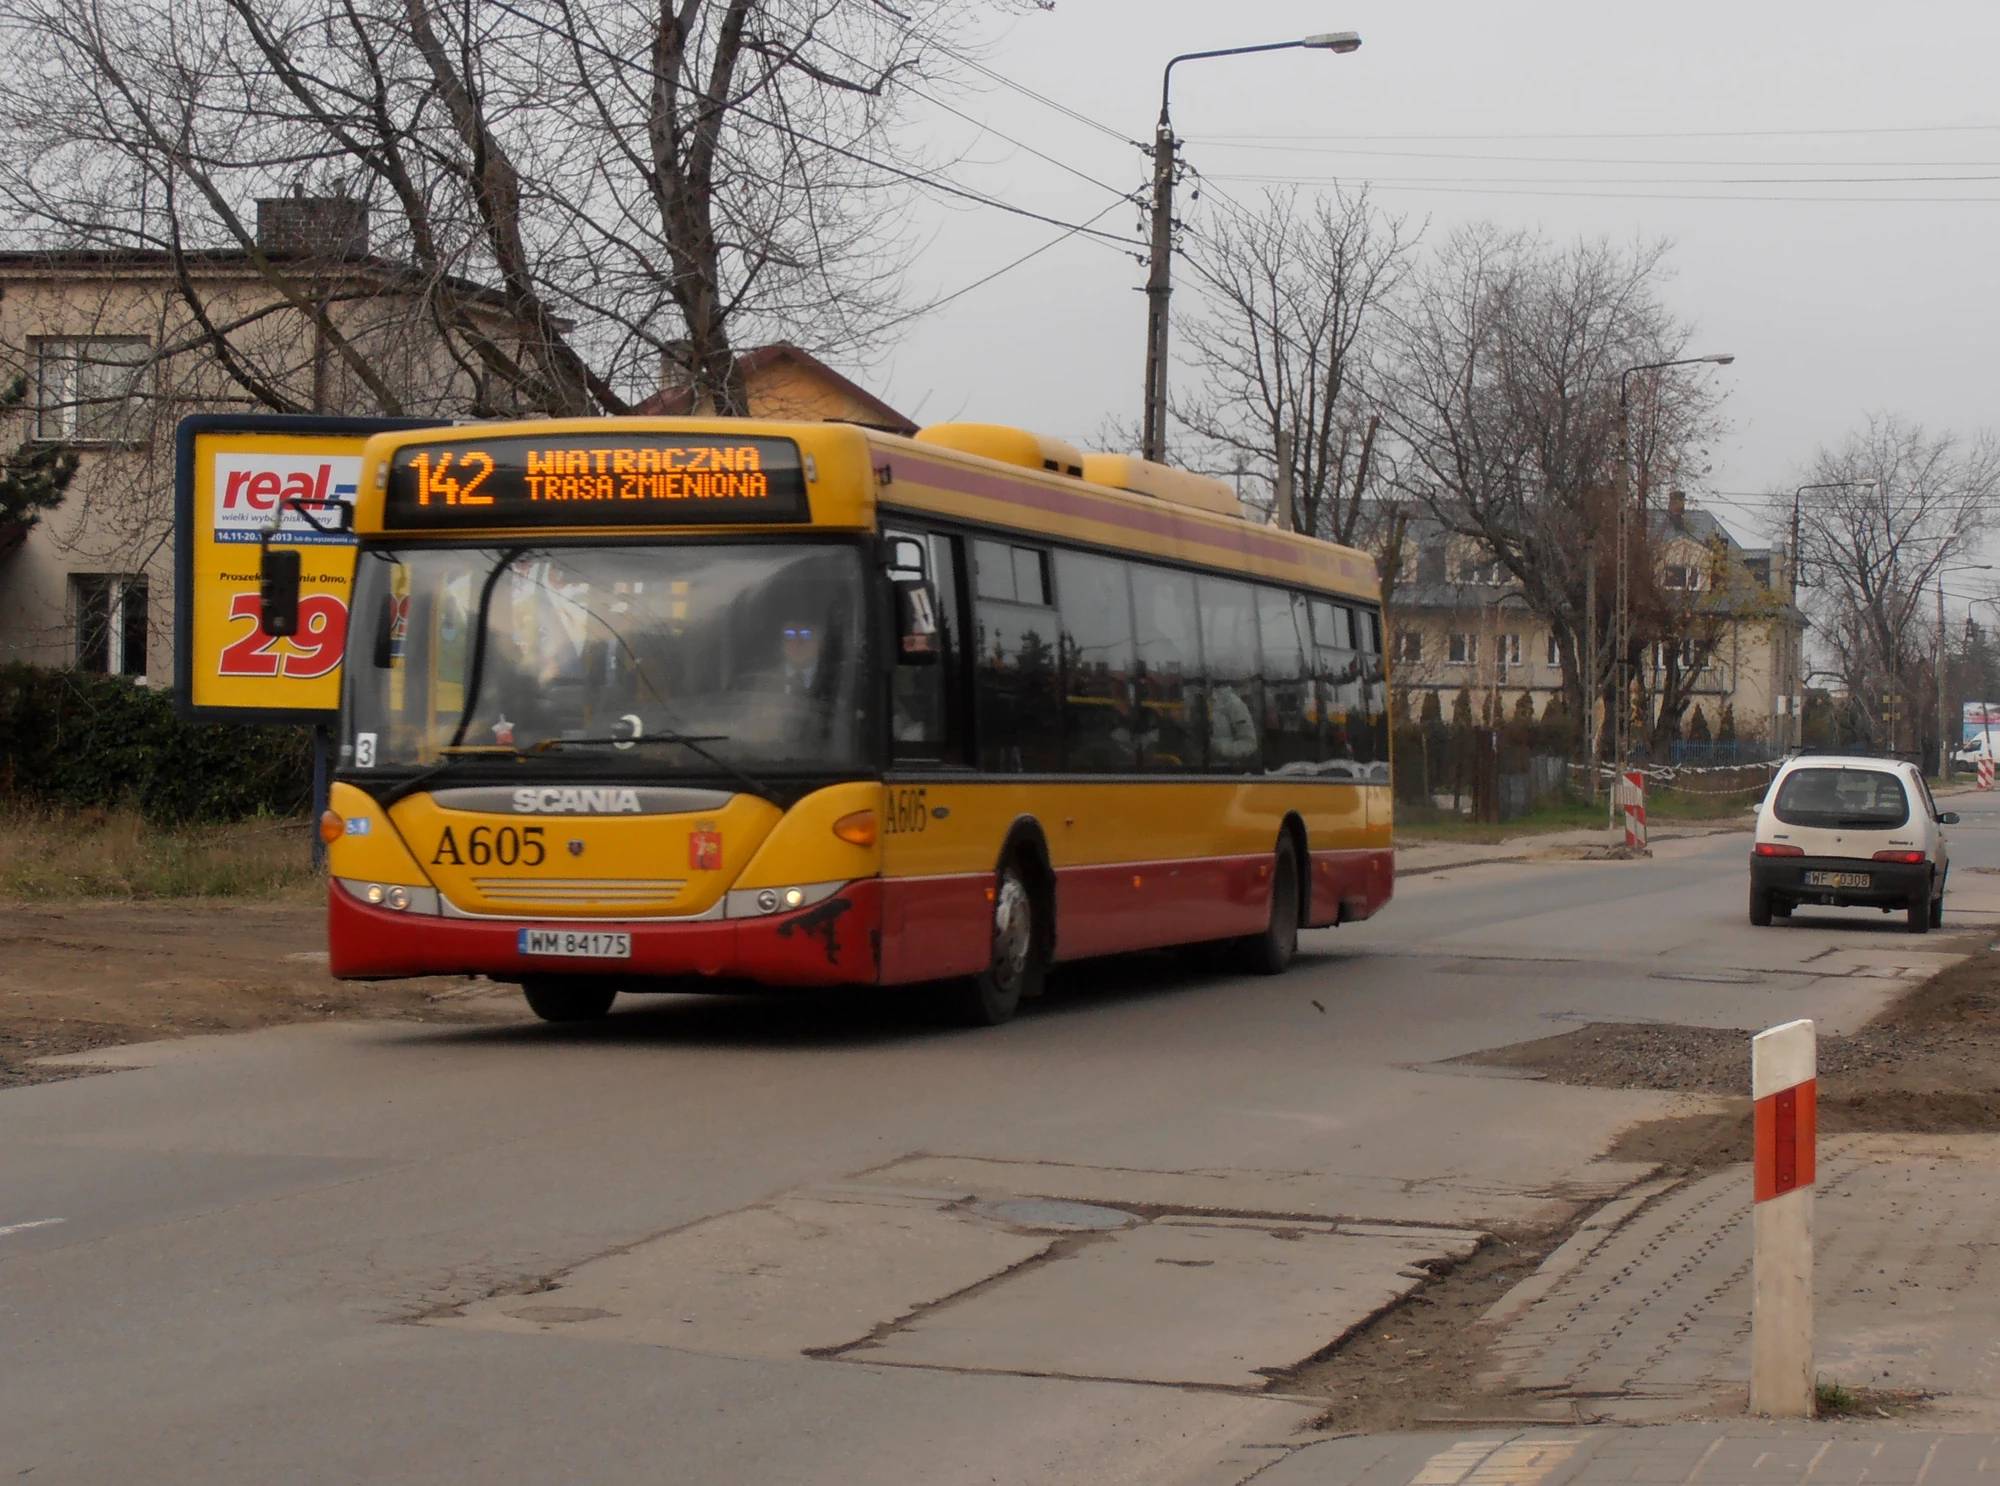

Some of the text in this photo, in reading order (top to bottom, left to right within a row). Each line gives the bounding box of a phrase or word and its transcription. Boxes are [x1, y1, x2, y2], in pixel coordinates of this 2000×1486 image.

[526, 446, 761, 475] WIATRACZNA
[408, 451, 495, 505] 142
[524, 472, 768, 501] TRASA ZMIENIONA
[221, 513, 248, 522] wielki
[219, 572, 262, 582] Proszek
[358, 739, 372, 765] 3
[512, 788, 642, 813] SCANIA
[884, 788, 927, 834] A605
[431, 825, 546, 866] A605
[531, 932, 627, 955] WM 84175
